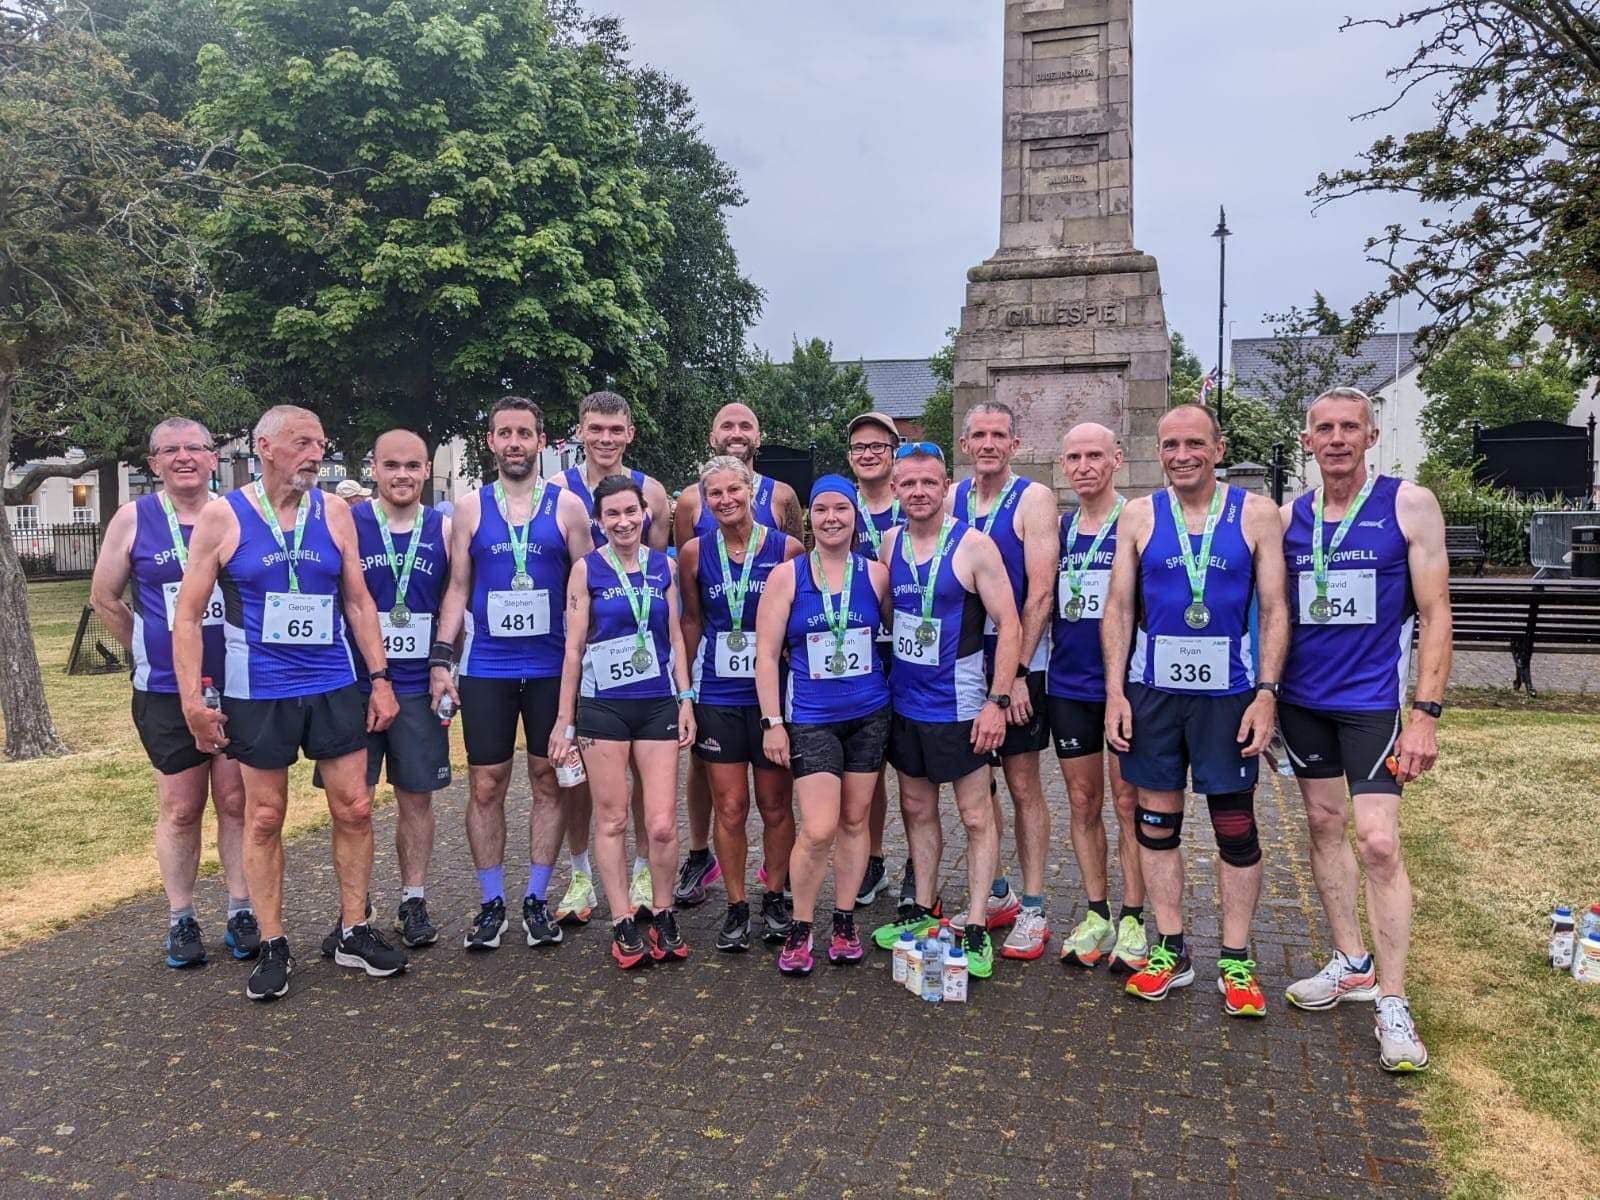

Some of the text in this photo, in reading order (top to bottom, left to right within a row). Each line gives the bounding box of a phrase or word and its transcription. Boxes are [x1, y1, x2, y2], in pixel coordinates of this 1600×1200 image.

[1007, 303, 1116, 327] GILLESPIE
[318, 466, 330, 477] er
[288, 603, 316, 613] George
[504, 600, 533, 609] Stephen
[287, 619, 313, 637] 65
[501, 613, 535, 631] 481
[383, 636, 416, 652] 493
[898, 636, 924, 658] 503
[1179, 647, 1202, 656] Ryan
[824, 652, 860, 672] 52
[1169, 663, 1212, 683] 336
